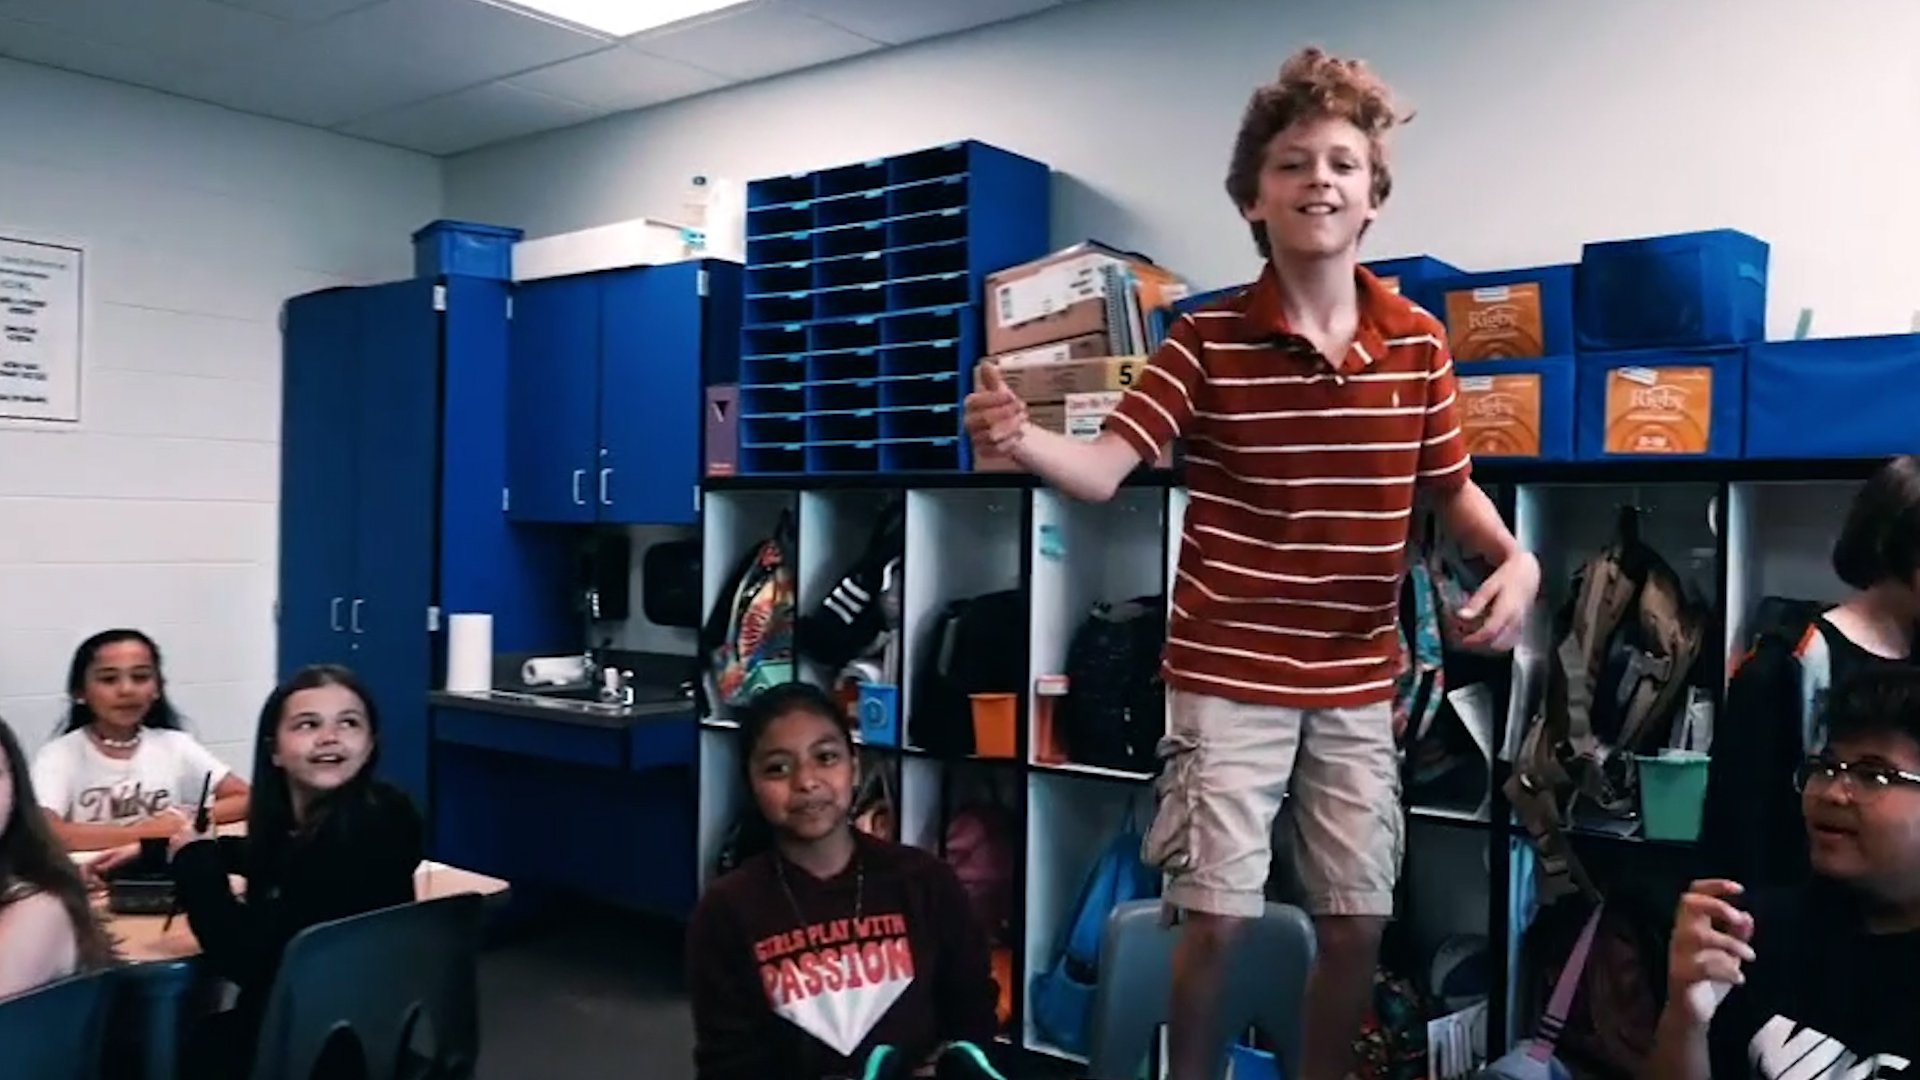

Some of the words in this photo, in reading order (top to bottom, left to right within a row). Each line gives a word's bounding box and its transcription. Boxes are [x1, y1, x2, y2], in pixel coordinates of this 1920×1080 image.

[1468, 309, 1518, 330] Rigby
[1119, 364, 1133, 385] 5
[1631, 388, 1686, 412] Rigby
[755, 929, 806, 961] GIRLS
[808, 918, 849, 945] PLAY
[853, 914, 907, 938] WITH
[760, 937, 915, 1008] PASSION
